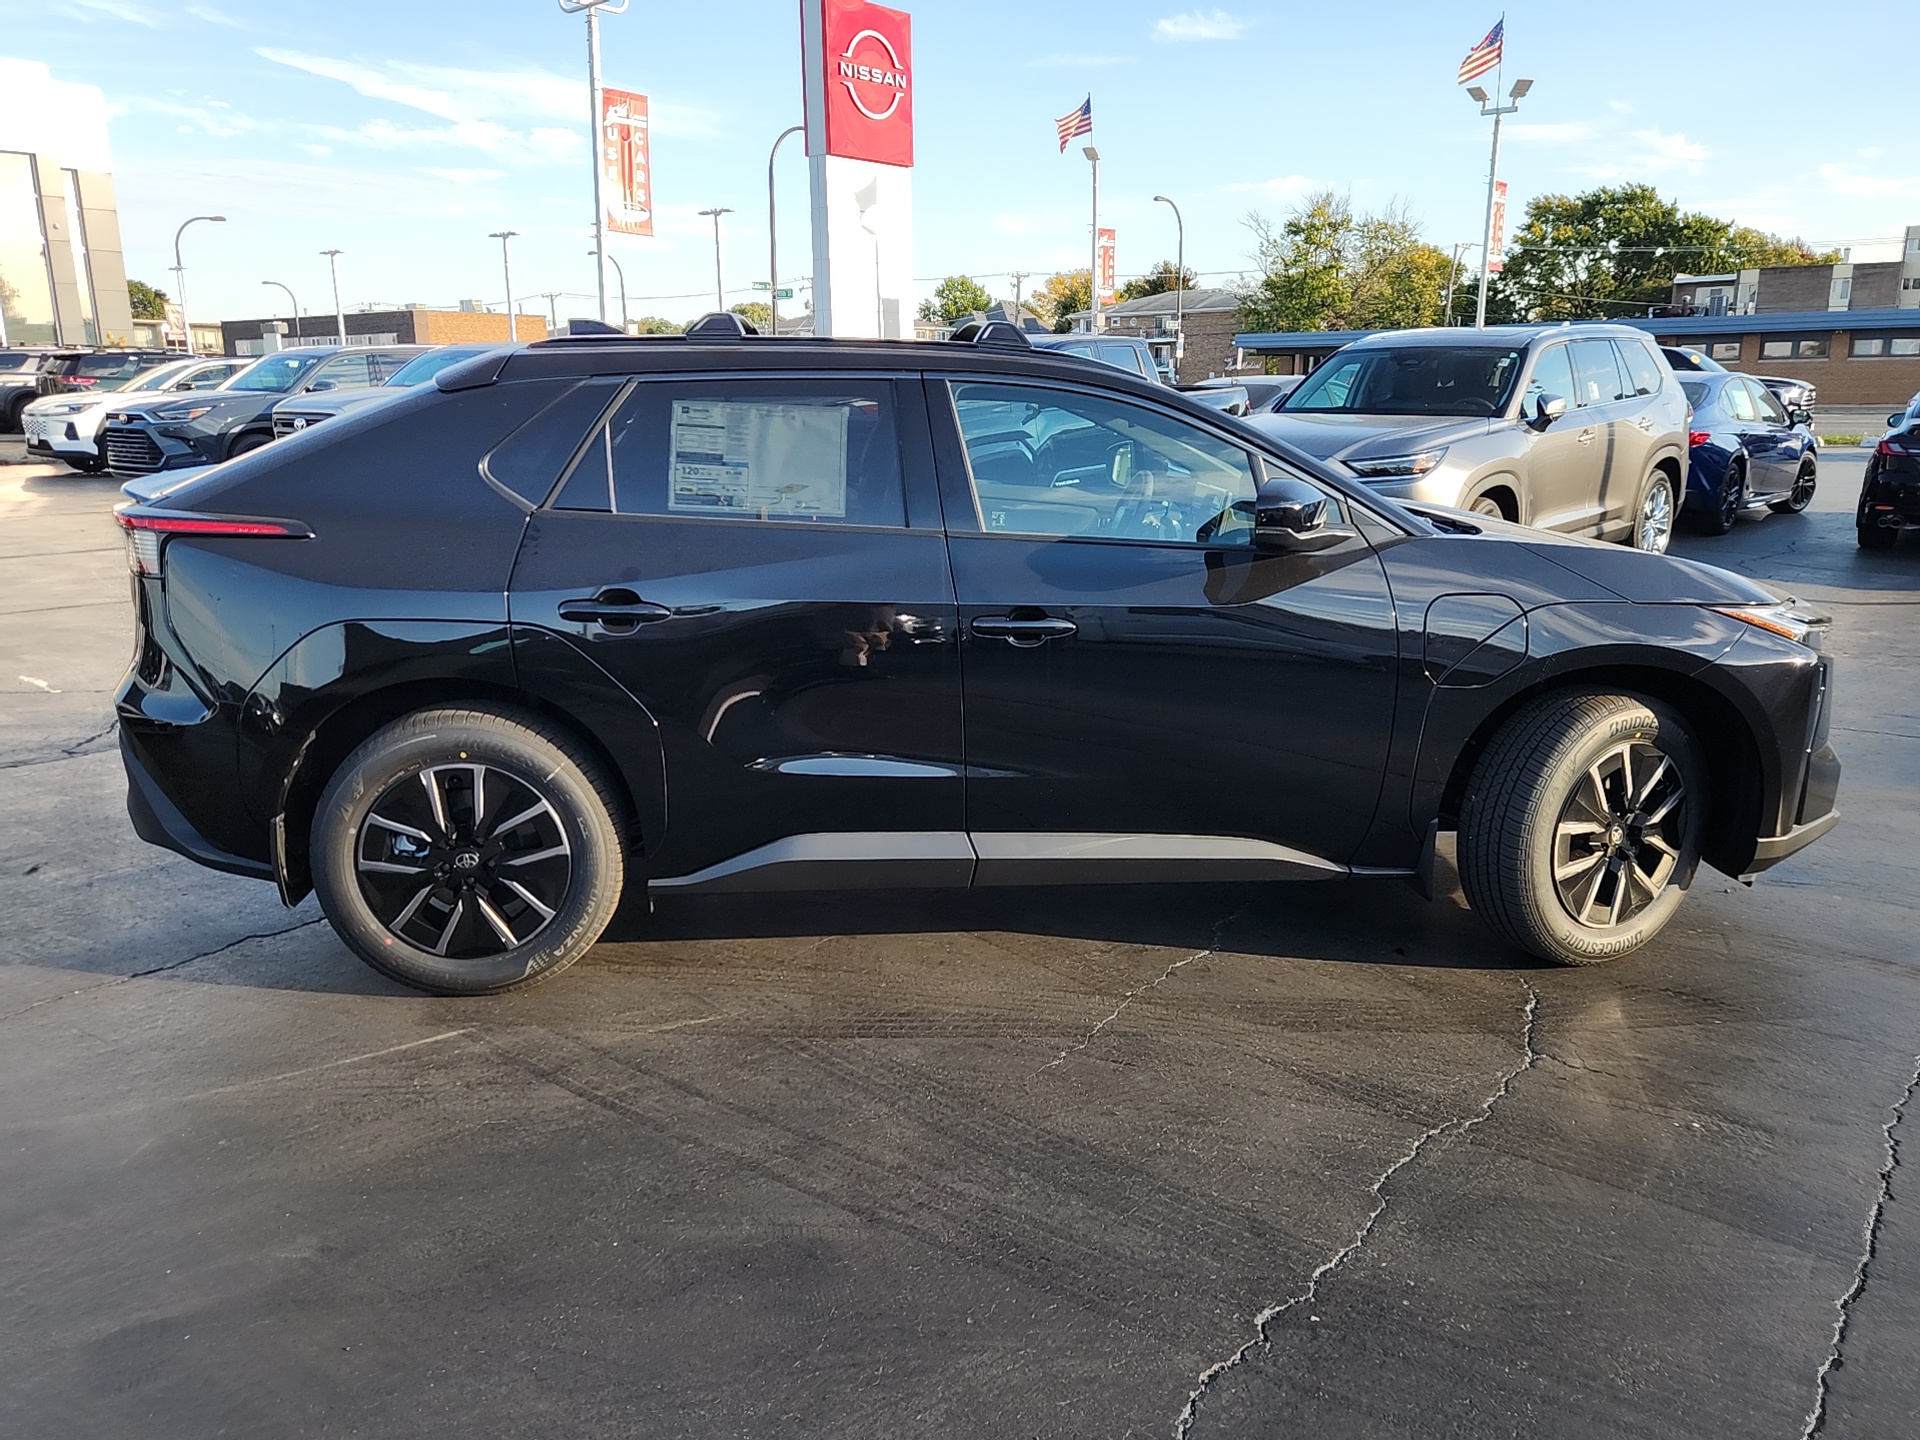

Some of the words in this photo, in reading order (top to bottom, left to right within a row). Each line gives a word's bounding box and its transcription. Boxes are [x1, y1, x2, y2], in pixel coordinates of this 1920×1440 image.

[840, 61, 907, 89] NISSAN
[607, 127, 619, 192] USE
[634, 131, 647, 203] CARS
[682, 466, 699, 476] 120
[553, 879, 600, 957] TURANZA
[1560, 929, 1645, 956] BRIDGESTONE
